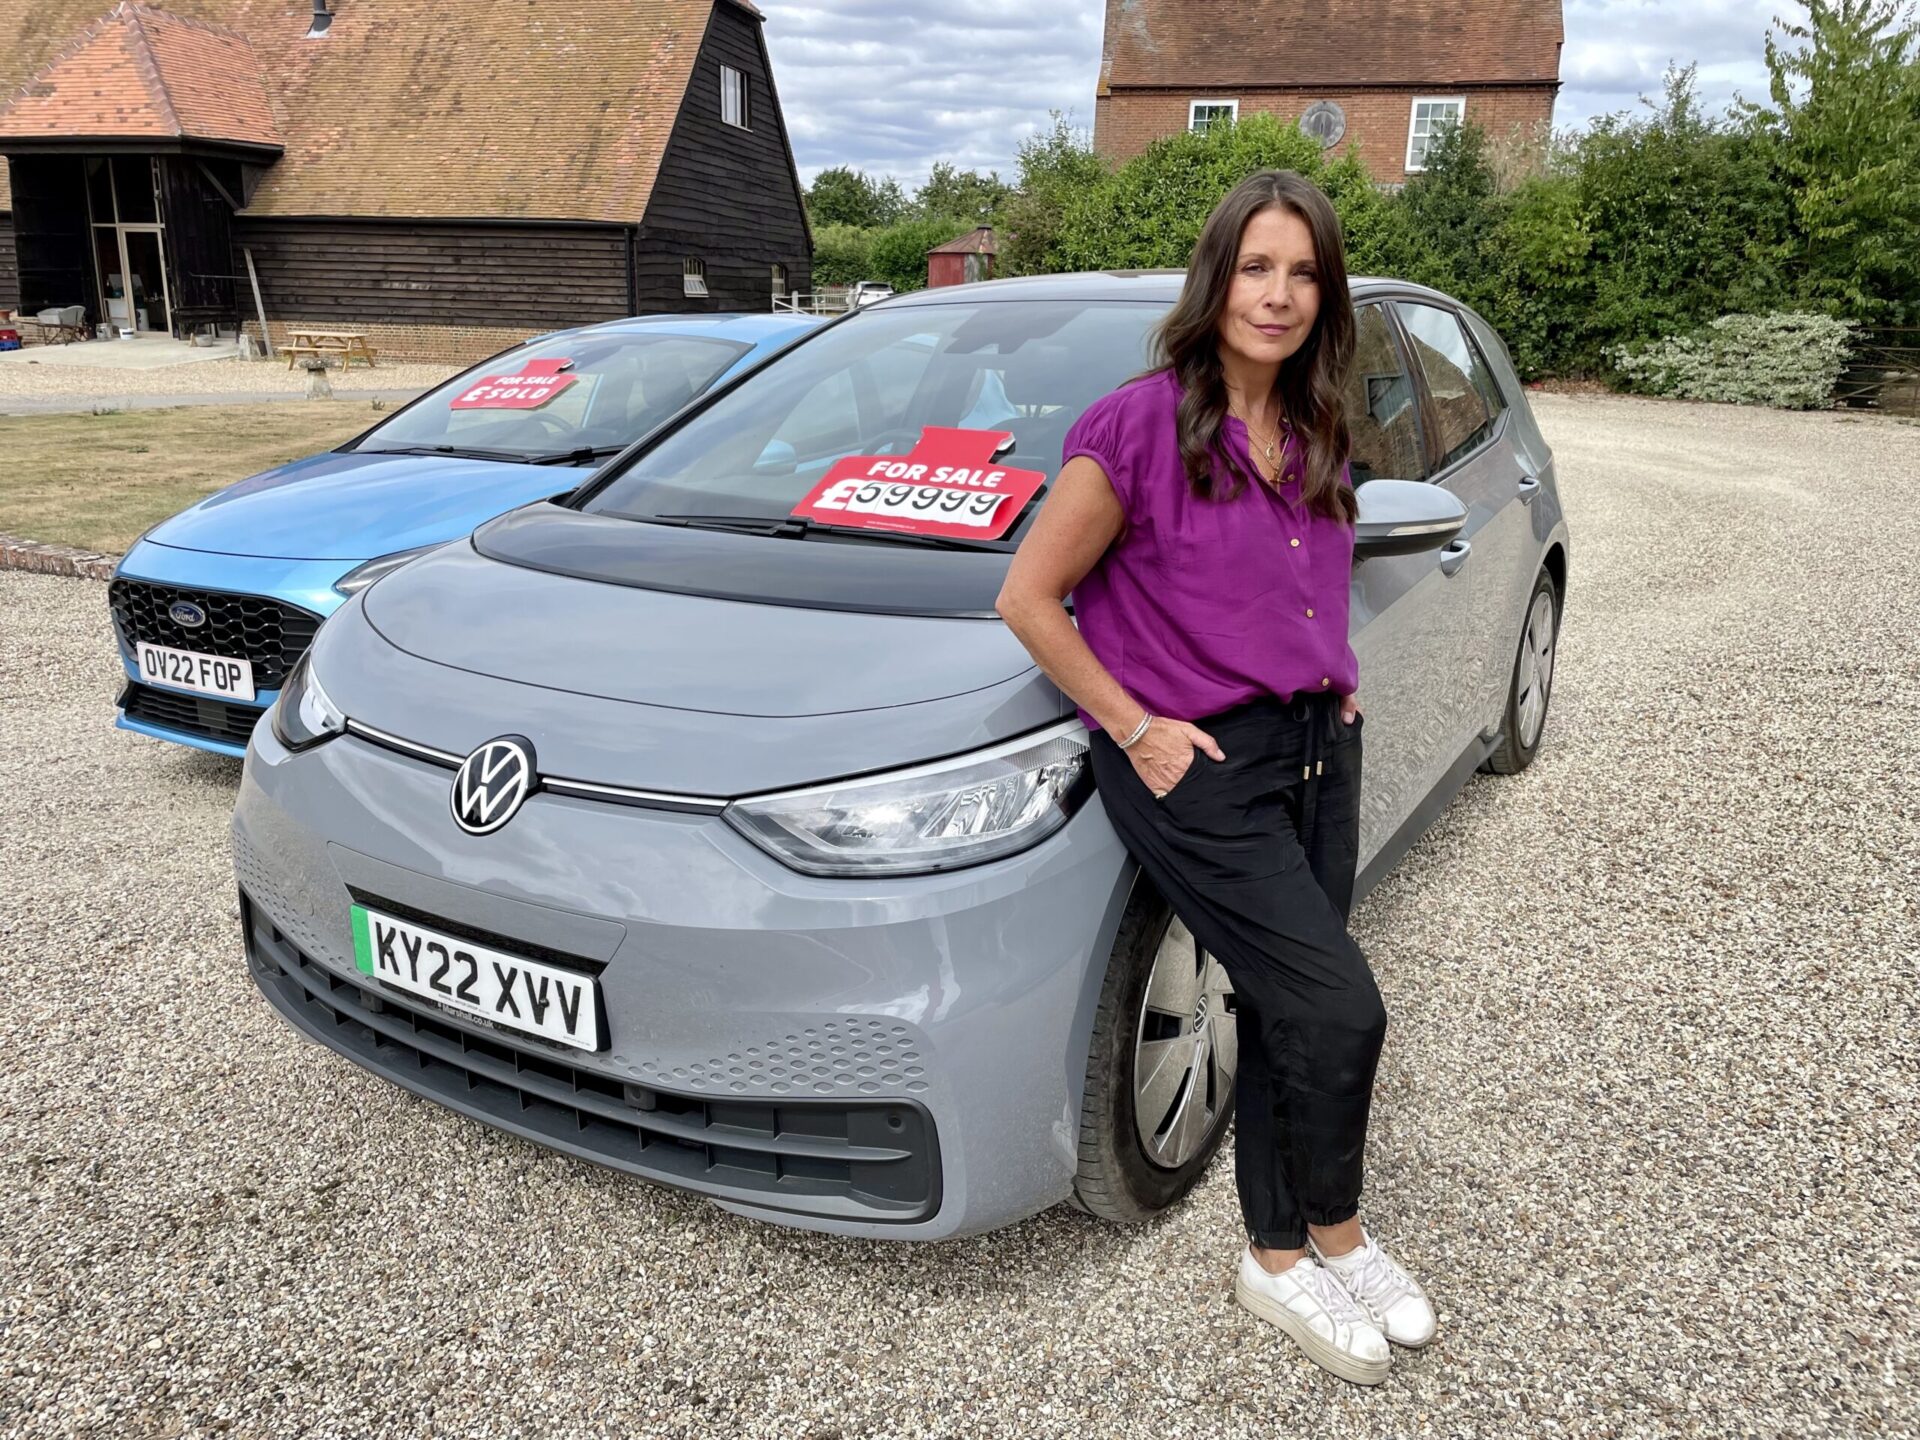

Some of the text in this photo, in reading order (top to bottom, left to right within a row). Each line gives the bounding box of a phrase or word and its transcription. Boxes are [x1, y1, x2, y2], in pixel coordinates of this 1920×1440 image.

[494, 376, 561, 385] FOR SALE
[867, 461, 1006, 488] FOR SALE
[812, 478, 1002, 516] £59999
[175, 607, 195, 622] Ford
[145, 648, 241, 692] OV22 FOP
[375, 922, 581, 1035] KY22 XVV
